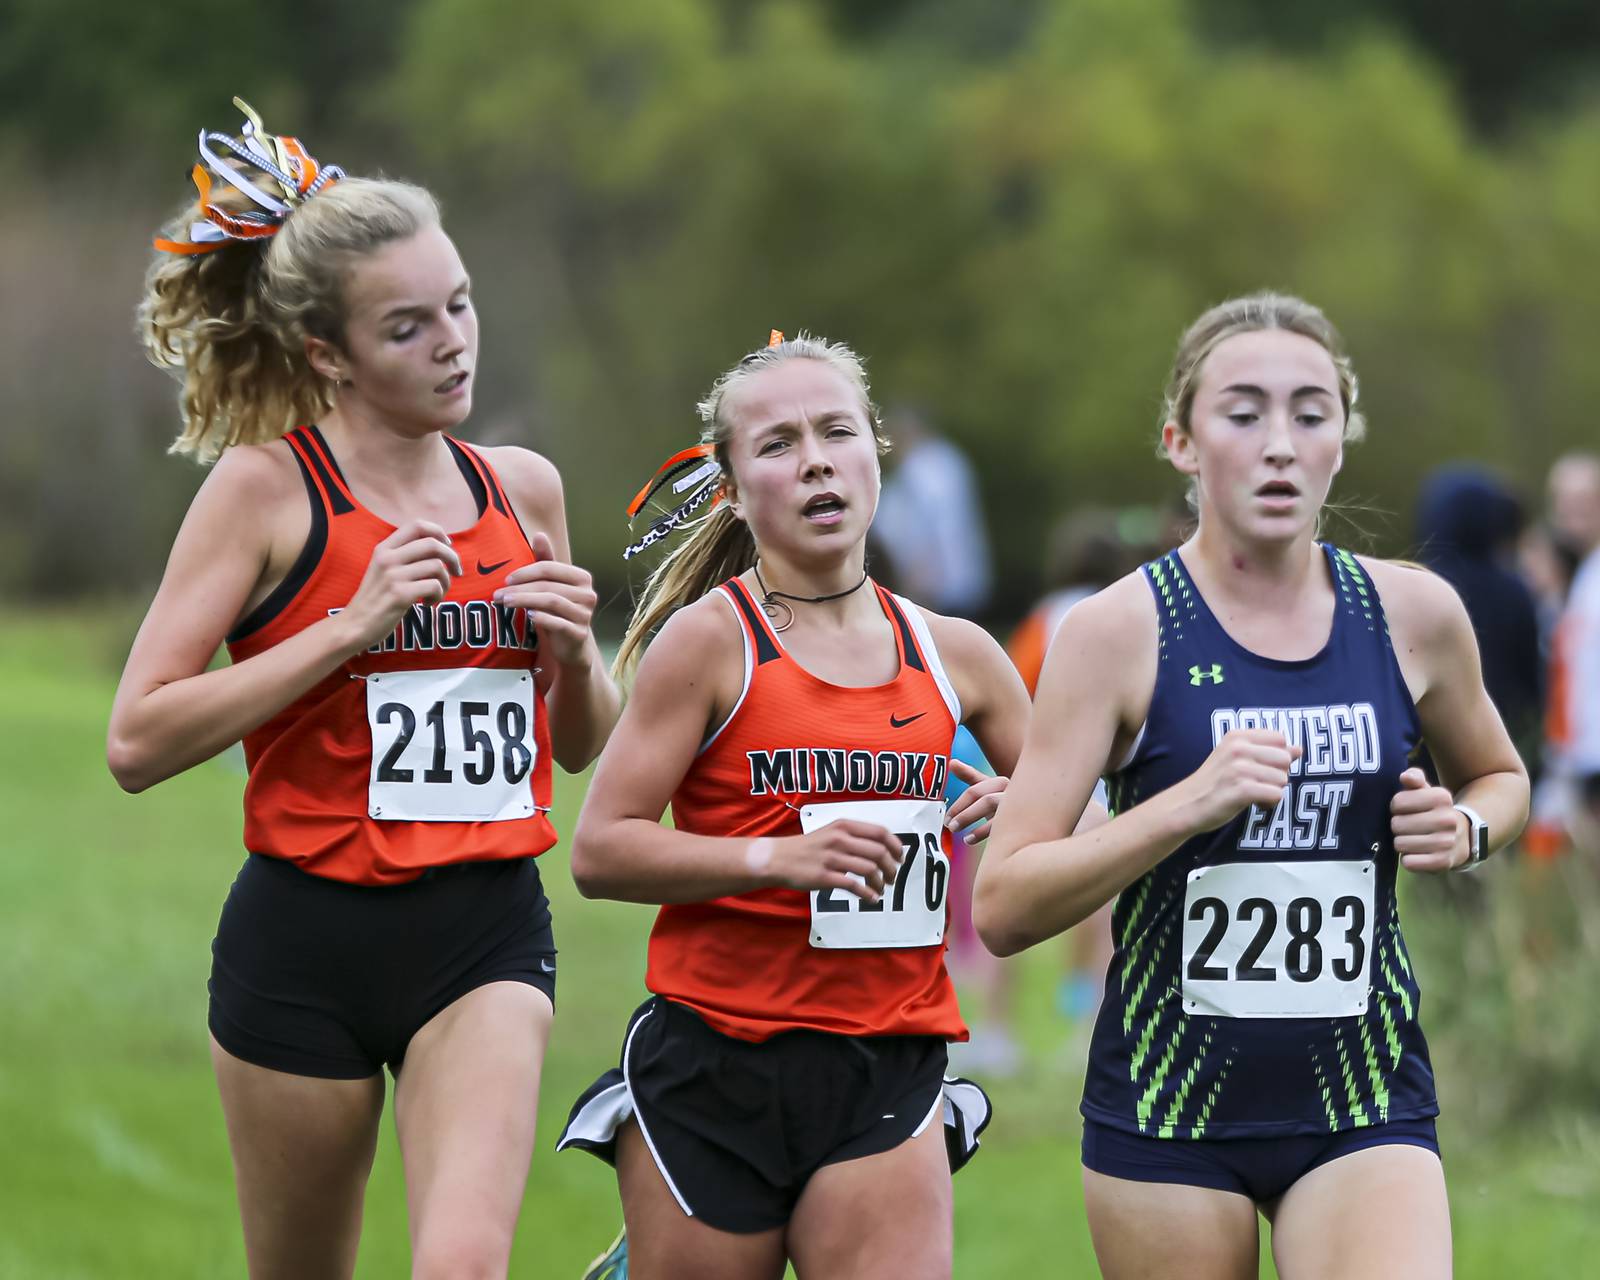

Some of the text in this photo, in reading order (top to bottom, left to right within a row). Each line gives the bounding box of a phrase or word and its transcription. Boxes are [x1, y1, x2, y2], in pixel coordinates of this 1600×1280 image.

[328, 601, 538, 653] NOOK
[376, 701, 531, 785] 2158
[747, 748, 947, 799] MINOOKA
[1237, 780, 1353, 850] EAST
[816, 832, 946, 913] 76
[1187, 896, 1365, 982] 2283
